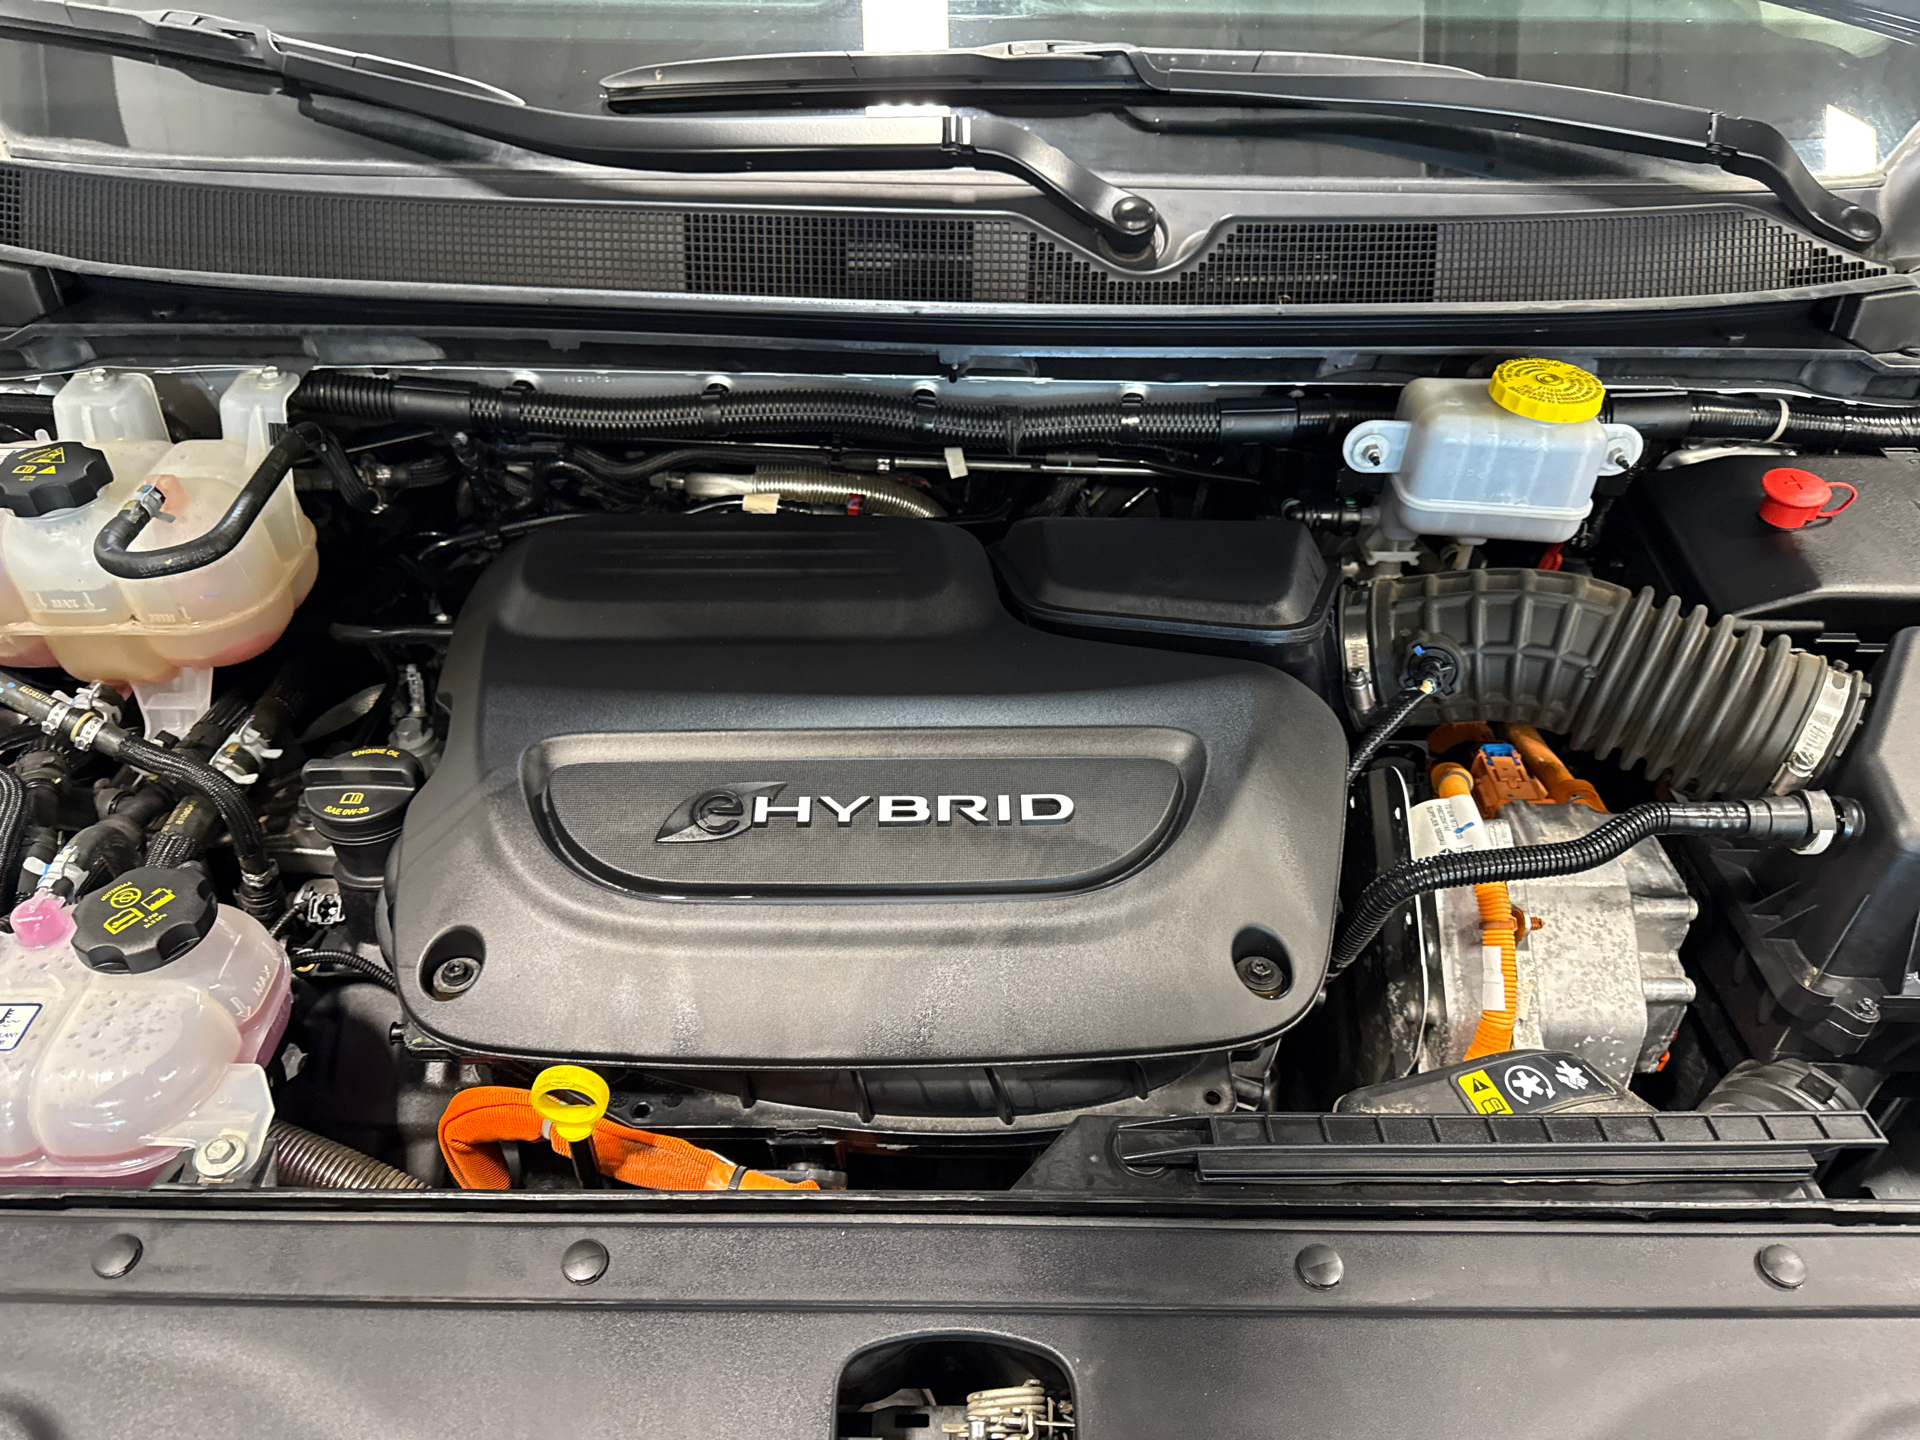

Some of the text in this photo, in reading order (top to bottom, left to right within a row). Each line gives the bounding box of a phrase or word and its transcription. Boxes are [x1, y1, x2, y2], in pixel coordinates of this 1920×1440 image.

[351, 748, 400, 758] ENGINE OIL
[323, 805, 370, 816] SAE 0W-20
[253, 964, 272, 997] MAX
